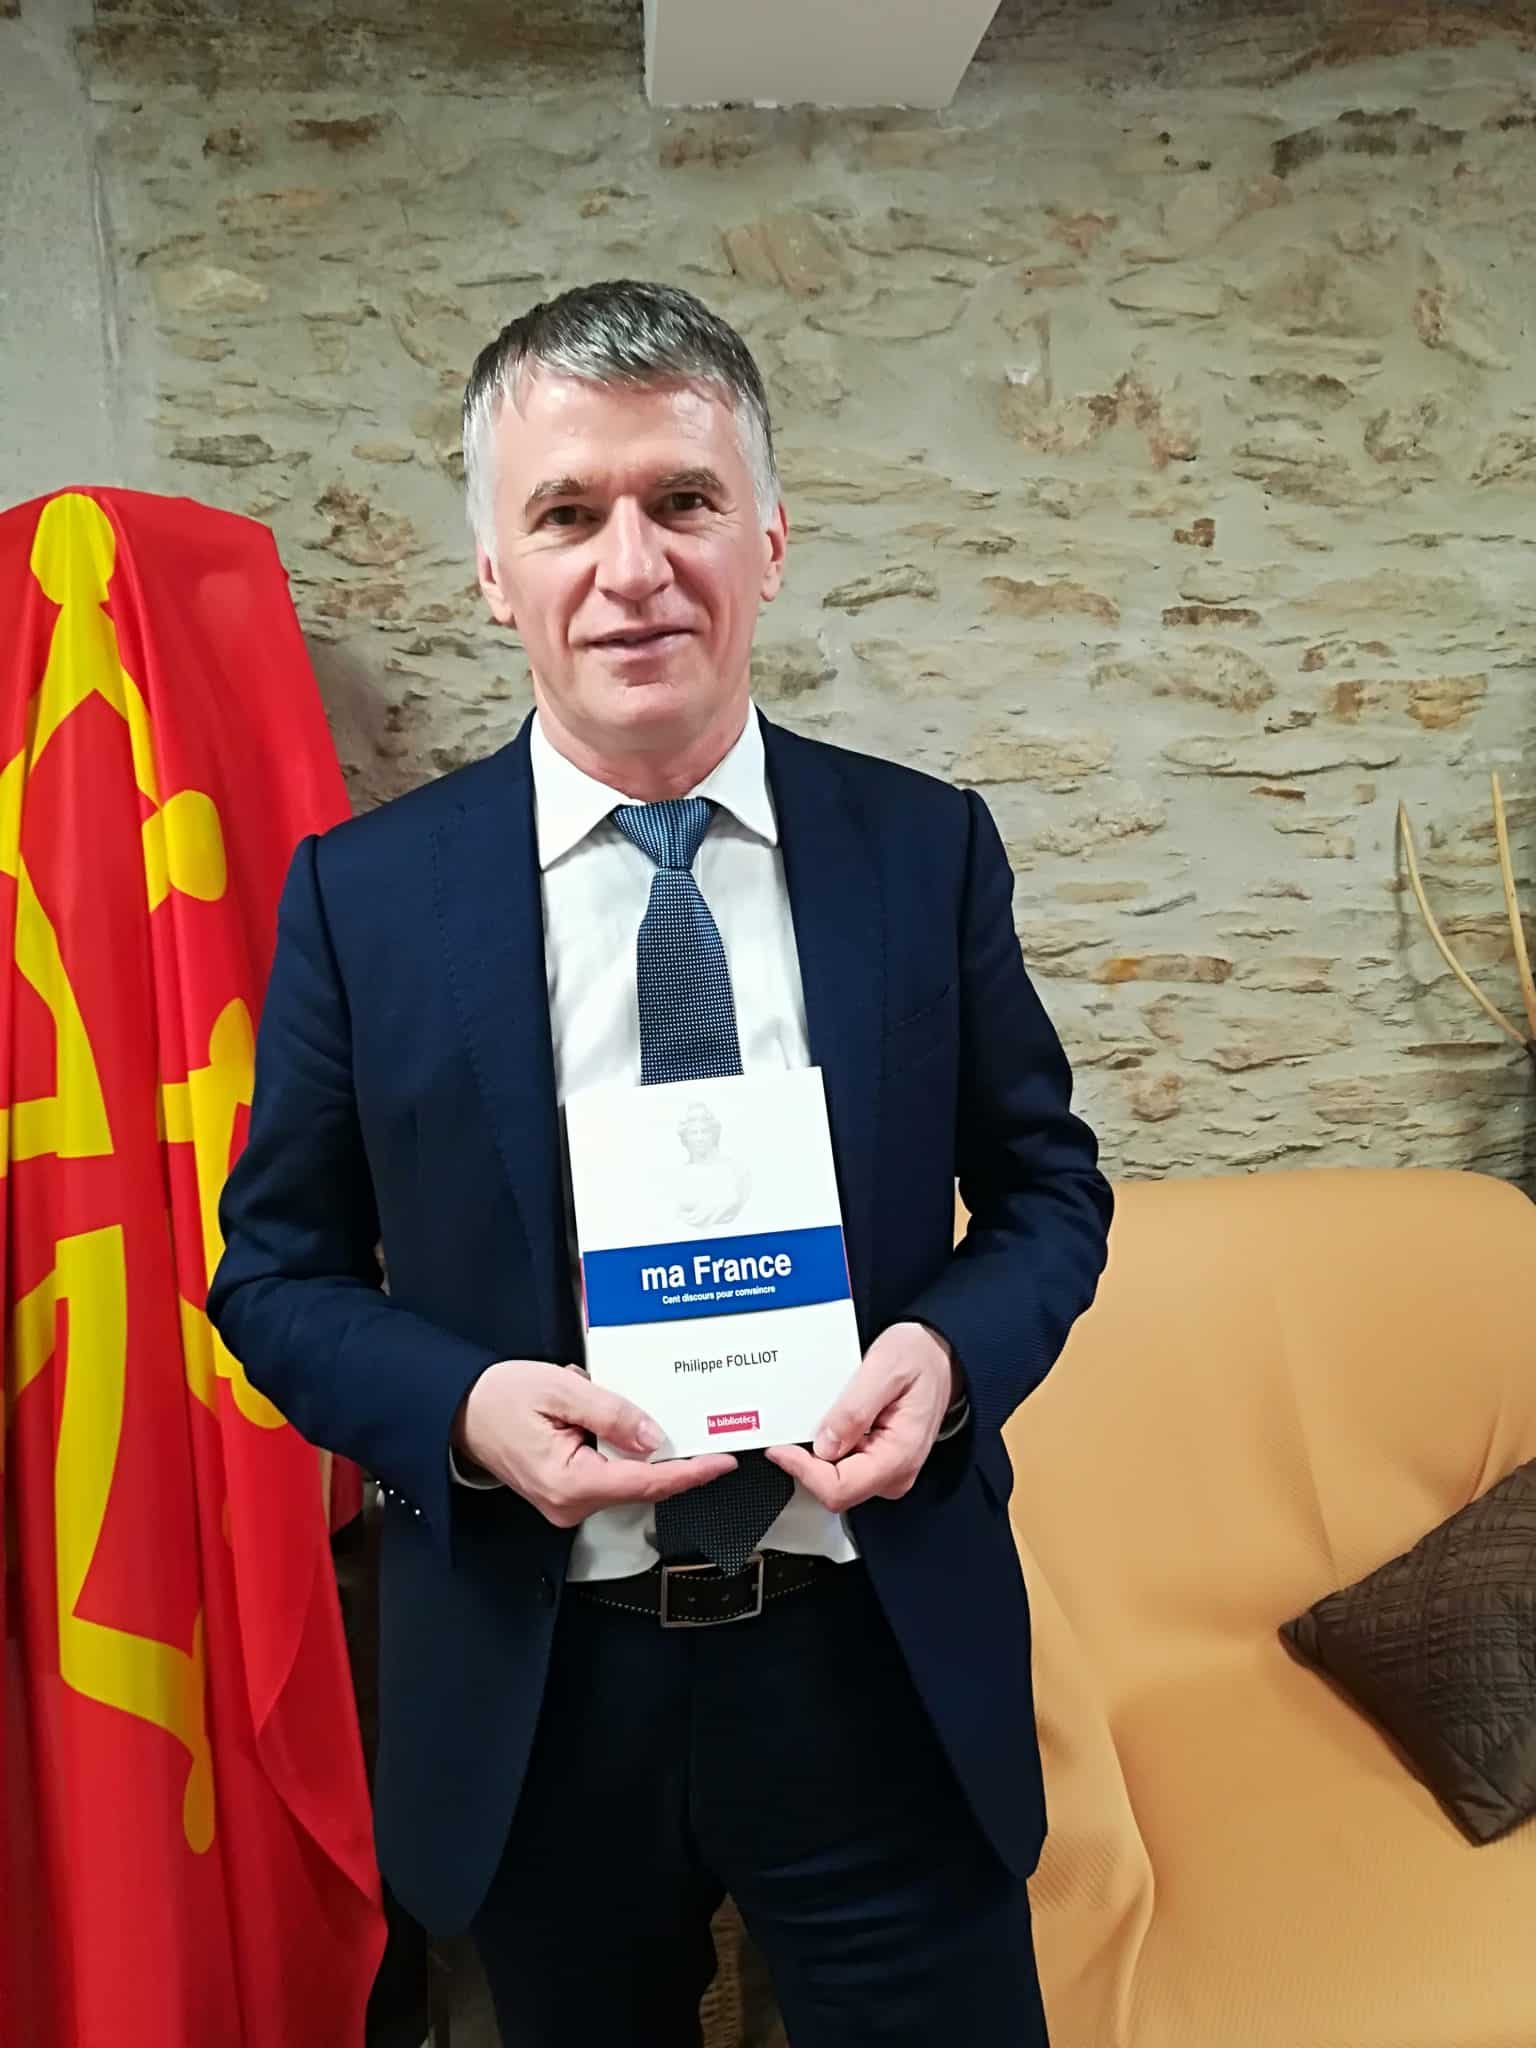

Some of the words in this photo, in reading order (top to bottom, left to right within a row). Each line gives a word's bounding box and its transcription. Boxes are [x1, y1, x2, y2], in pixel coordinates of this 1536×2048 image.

[641, 1265, 686, 1291] ma
[693, 1253, 792, 1285] France
[662, 1295, 681, 1305] Cent
[682, 1291, 715, 1303] discours
[715, 1289, 734, 1301] pour
[735, 1285, 776, 1297] convaincre
[674, 1359, 723, 1374] Philippe
[726, 1350, 779, 1368] FOLLIOT
[708, 1418, 716, 1428] la
